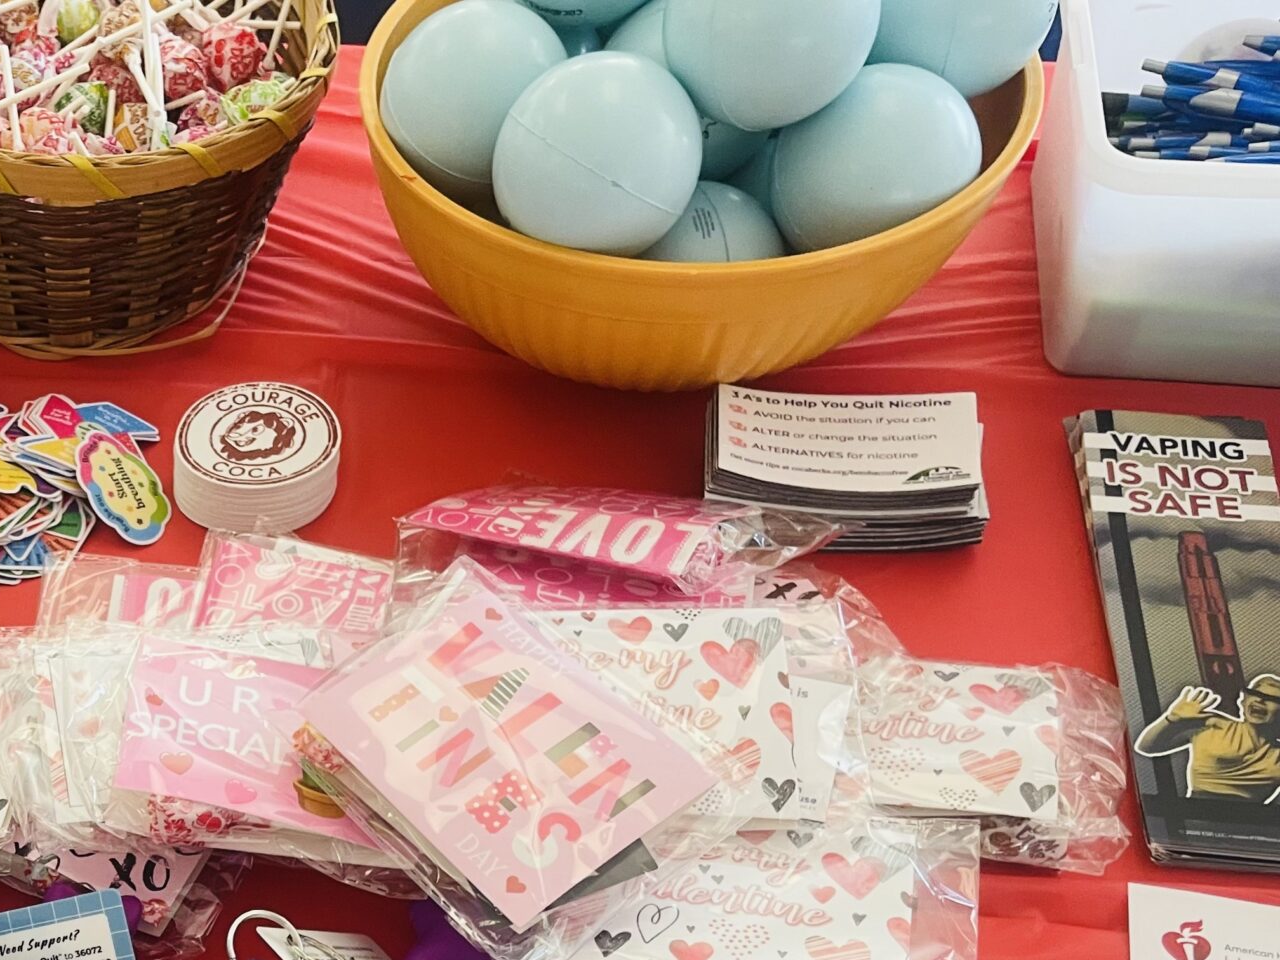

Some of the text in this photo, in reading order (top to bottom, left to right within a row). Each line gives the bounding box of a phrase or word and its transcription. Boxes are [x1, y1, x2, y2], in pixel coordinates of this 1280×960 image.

[215, 390, 322, 426] COURAGE
[732, 391, 952, 410] 3 A's to Help You Quit Nicotine
[753, 409, 936, 426] AVOID the situation if you can
[752, 426, 791, 438] ALTER
[808, 433, 855, 443] change
[858, 432, 879, 442] the
[881, 432, 938, 442] situation
[1111, 433, 1246, 461] VAPING
[751, 442, 919, 460] ALTERNATIVES for nicotine
[111, 457, 146, 511] breathing
[211, 460, 290, 480] COCA
[1106, 459, 1255, 493] IS NOT
[108, 472, 127, 499] Start
[1128, 490, 1244, 520] SAFE
[519, 507, 710, 577] LOVE
[619, 644, 693, 690] my
[178, 673, 260, 714] U R
[129, 712, 291, 766] SPECIAL
[454, 833, 510, 878] DAY
[26, 929, 80, 952] Support?
[64, 952, 74, 960] to
[75, 945, 103, 958] 36072
[1224, 943, 1274, 959] American
